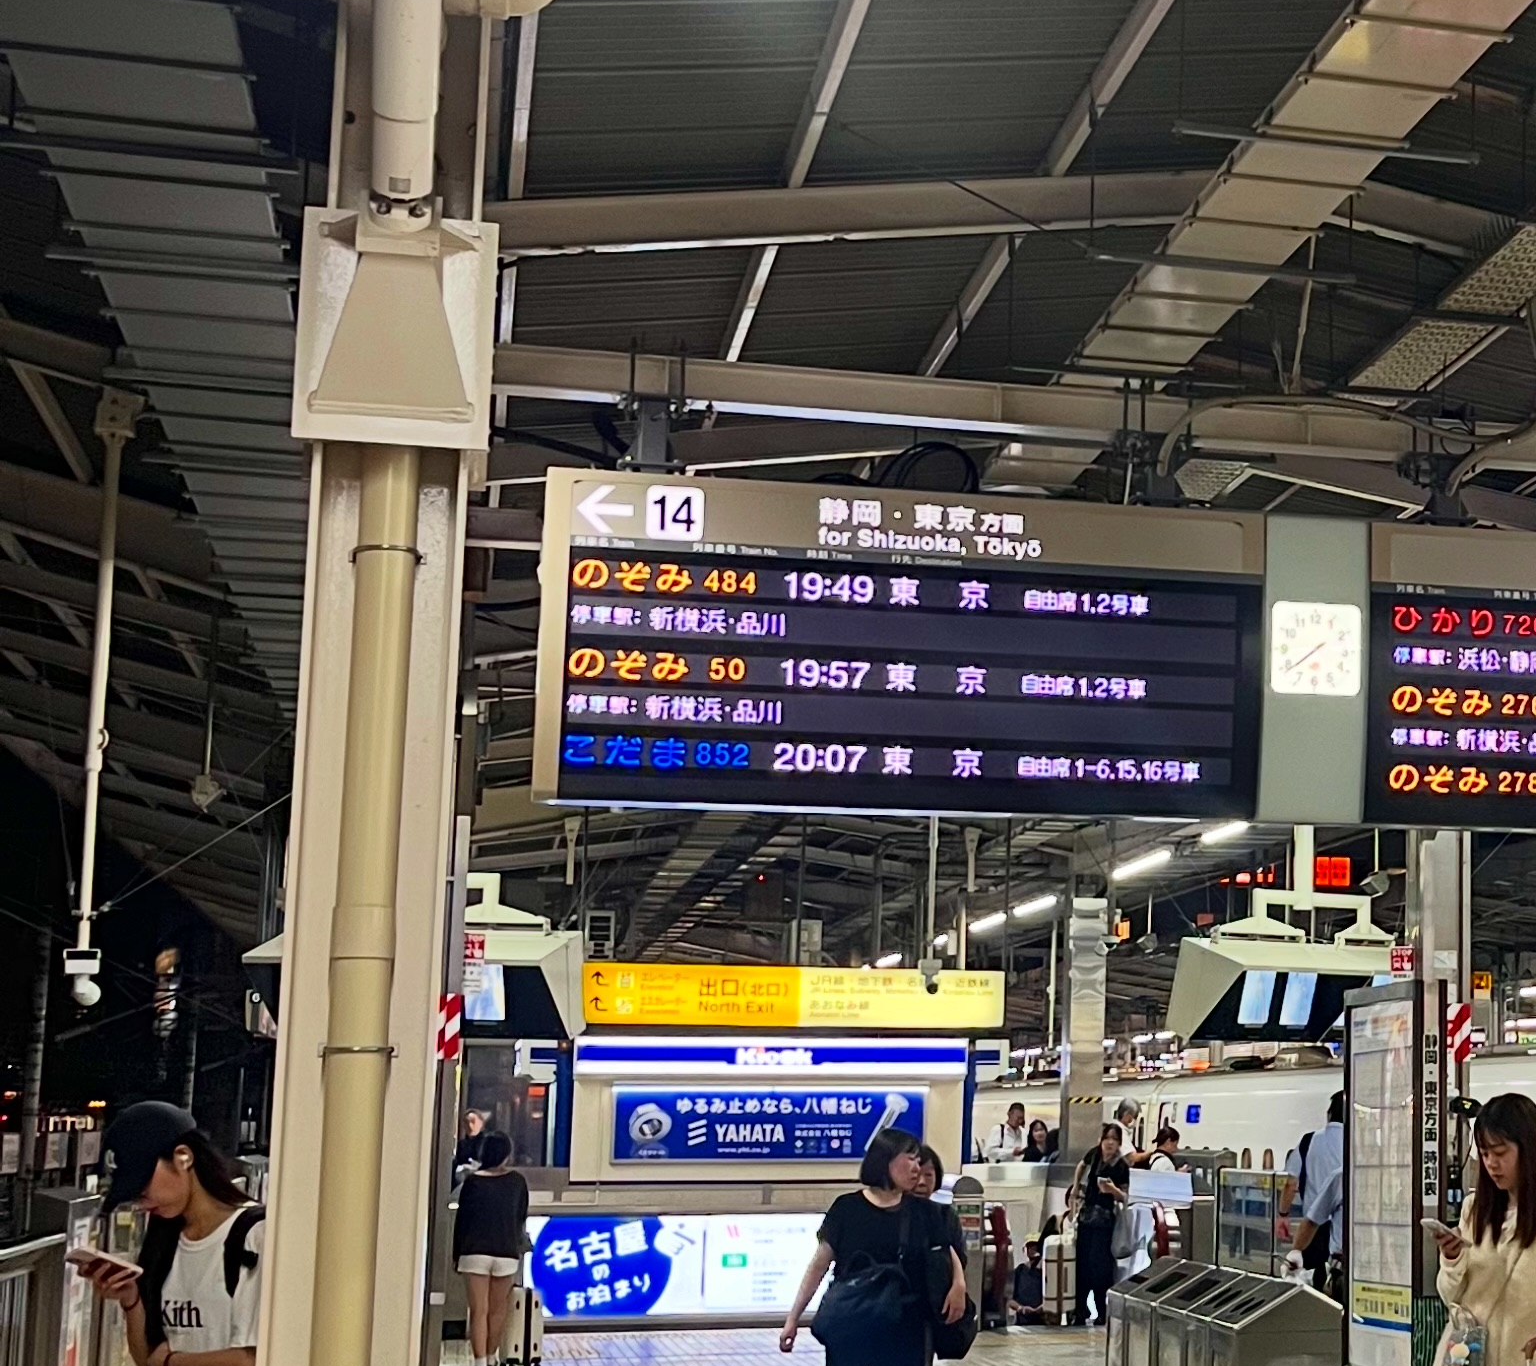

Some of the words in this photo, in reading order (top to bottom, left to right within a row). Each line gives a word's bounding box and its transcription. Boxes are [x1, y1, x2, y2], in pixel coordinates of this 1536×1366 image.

[653, 495, 696, 533] 14
[818, 526, 852, 547] for
[857, 527, 967, 556] Shizuoka,
[973, 534, 1042, 561] Tōkyō
[571, 558, 693, 593] のぞみ
[703, 569, 757, 595] 484
[783, 570, 875, 605] 19:49
[1392, 606, 1495, 636] ひかり
[567, 648, 690, 682] のぞみ
[708, 657, 746, 682] 50
[780, 658, 871, 691] 19:57
[1391, 685, 1492, 717] のぞみ
[563, 735, 686, 770] こだま
[695, 741, 751, 767] 852
[772, 742, 868, 774] 20:07
[1388, 763, 1489, 794] のぞみ
[699, 1001, 740, 1014] North
[746, 1001, 775, 1014] Exit
[715, 1123, 785, 1142] YAHATA
[591, 1262, 610, 1281] の
[566, 1272, 651, 1312] お泊まり
